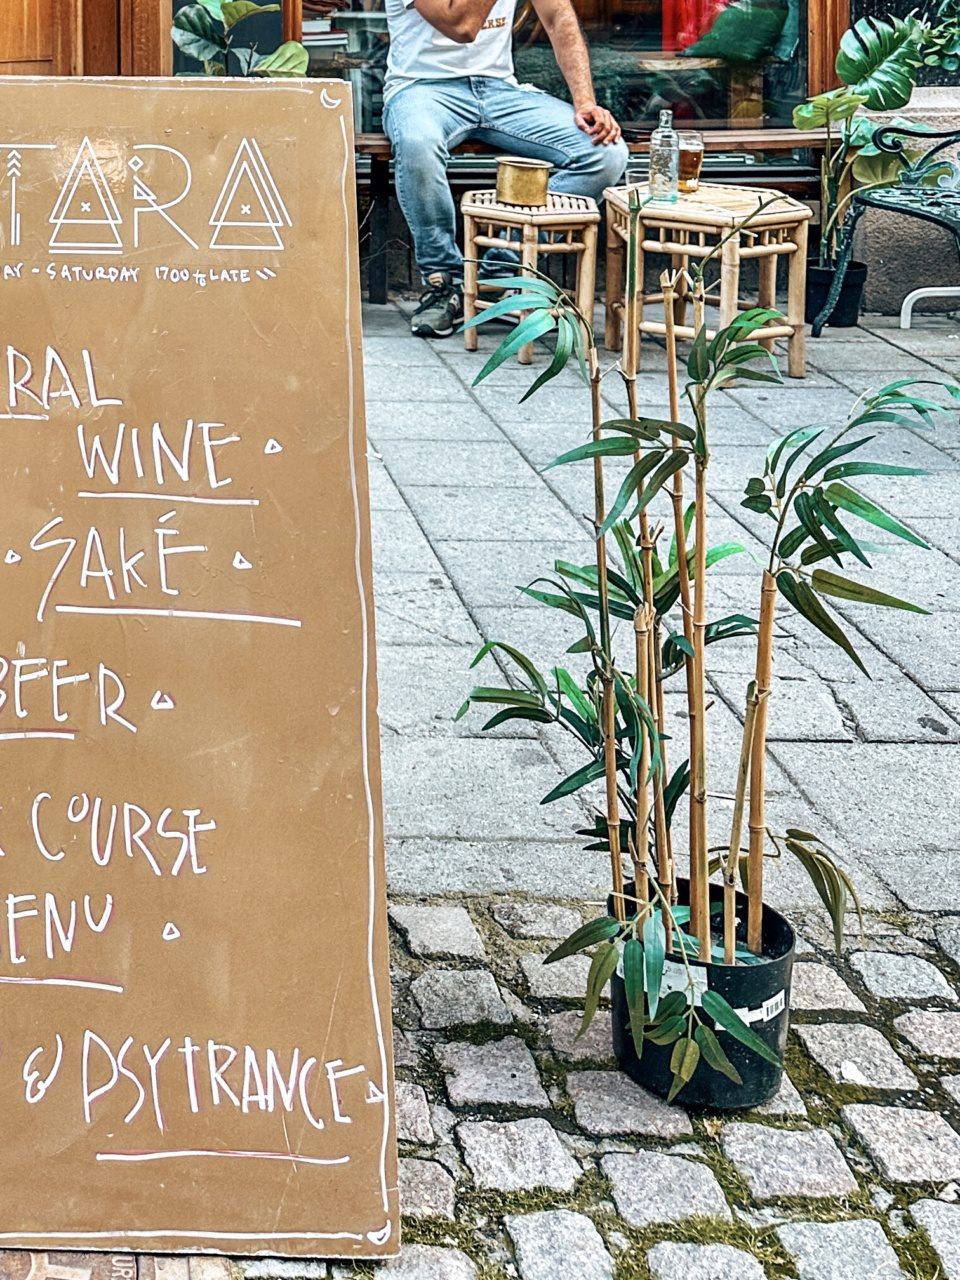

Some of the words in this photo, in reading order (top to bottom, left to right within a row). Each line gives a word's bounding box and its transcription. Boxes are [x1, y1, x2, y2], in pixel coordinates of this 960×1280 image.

[45, 265, 140, 283] SATURDAY
[155, 266, 191, 283] 1700
[209, 269, 252, 283] LATE
[77, 419, 241, 489] WINE
[31, 790, 216, 876] COURSE
[80, 1028, 367, 1133] PSYTRANCE
